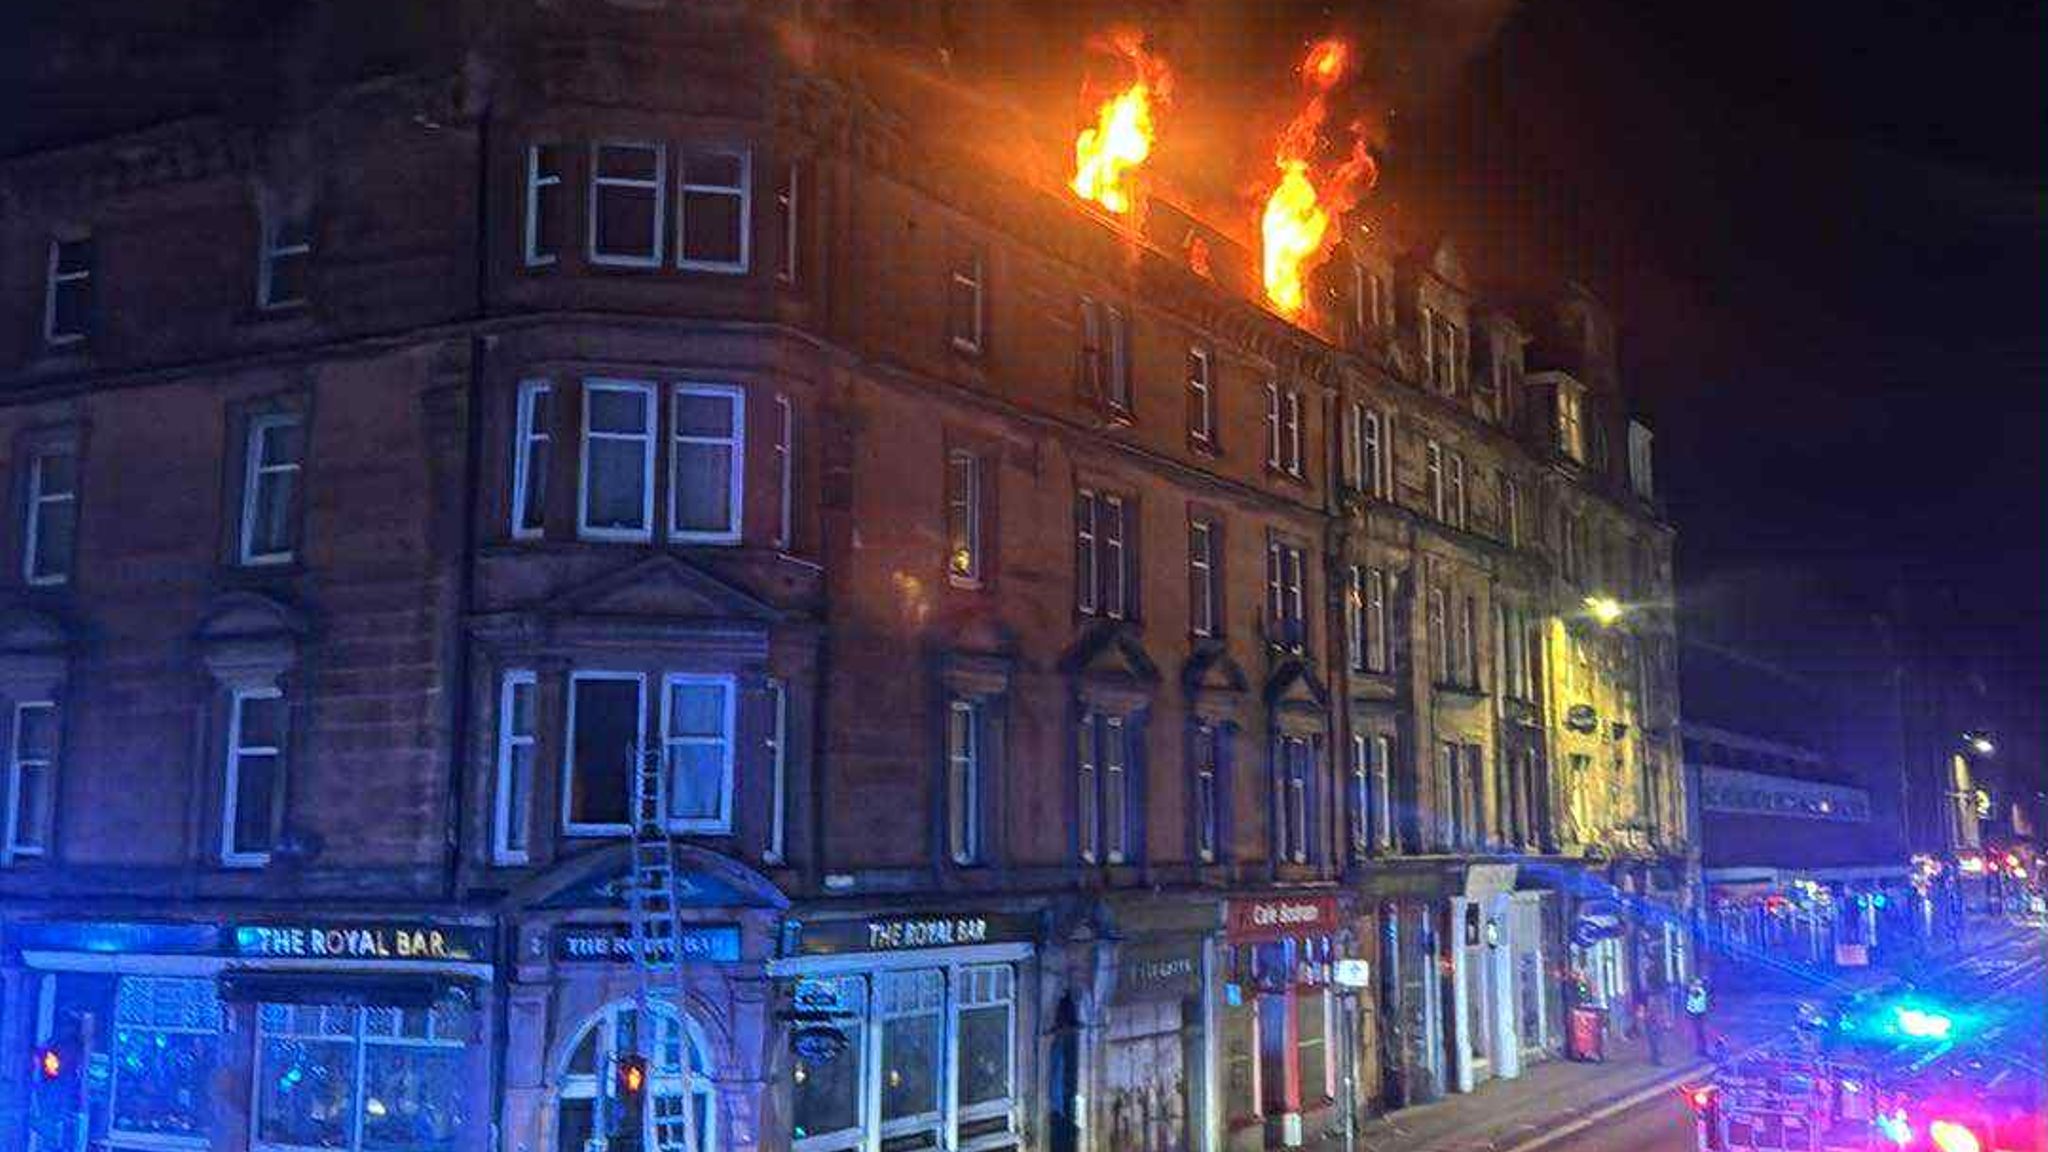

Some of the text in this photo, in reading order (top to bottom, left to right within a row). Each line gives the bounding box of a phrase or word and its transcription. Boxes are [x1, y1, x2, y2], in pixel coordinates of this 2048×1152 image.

[257, 927, 446, 958] THE ROYAL BAR
[868, 917, 986, 948] THE ROYAL BAR
